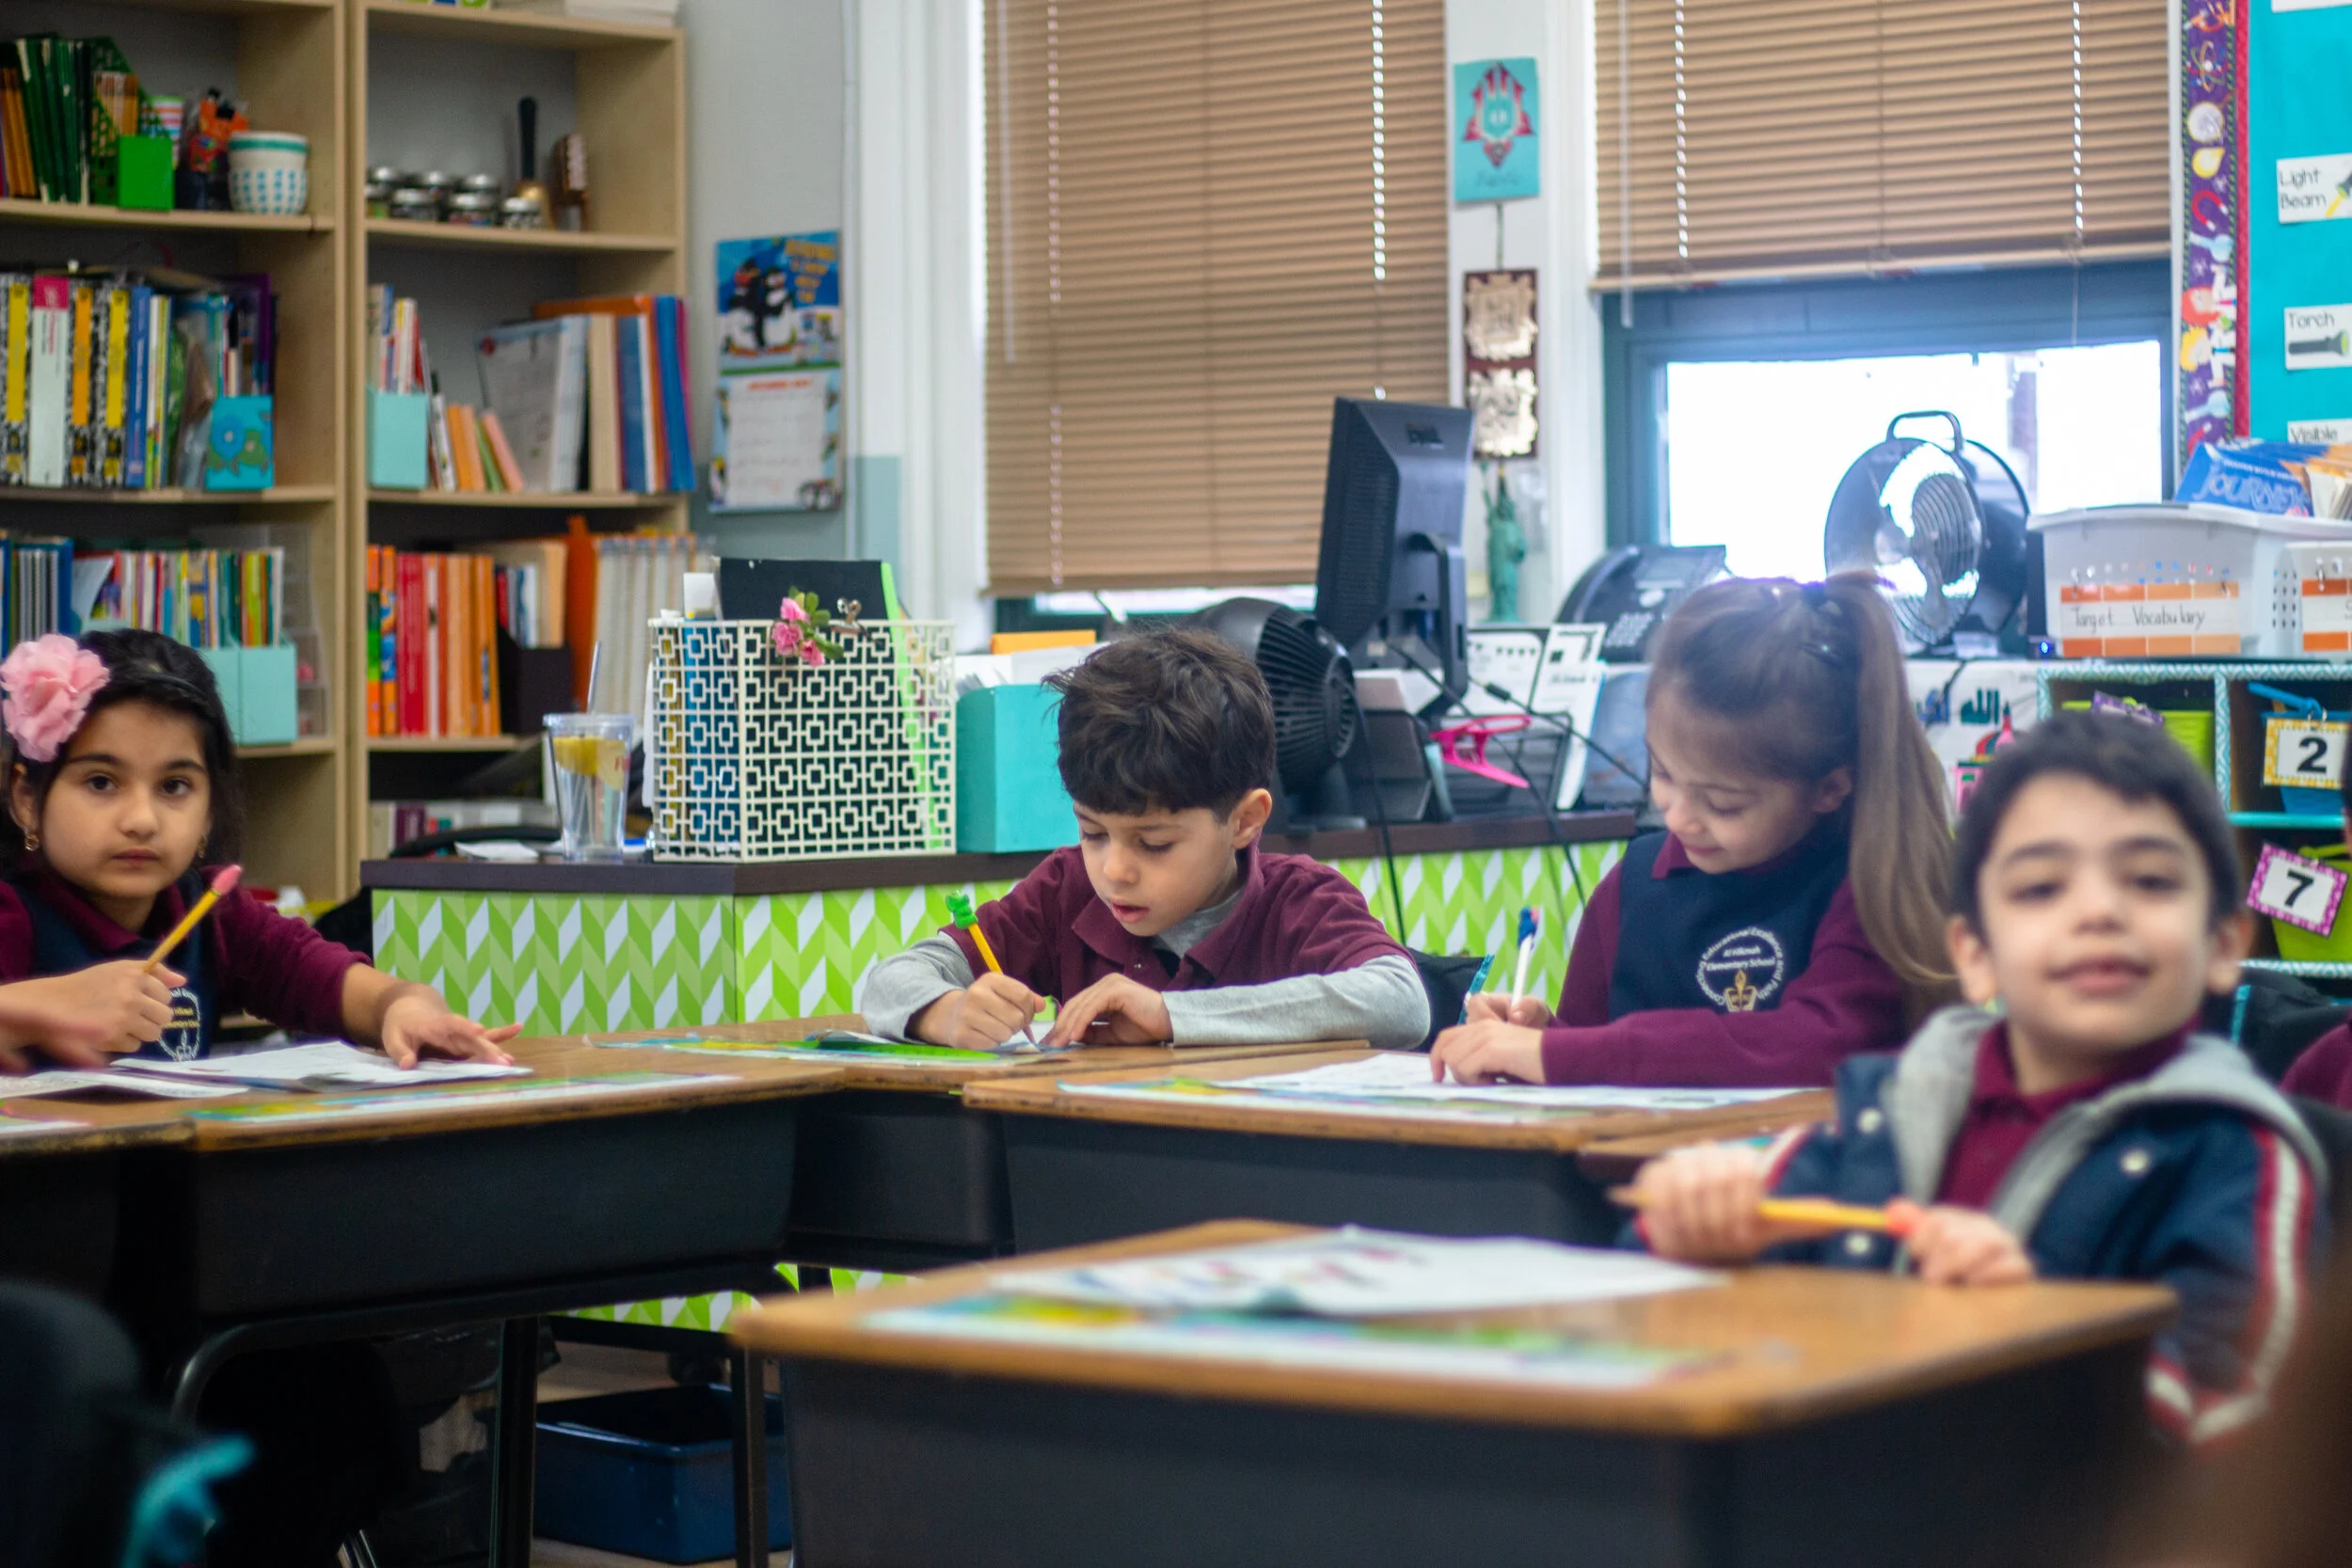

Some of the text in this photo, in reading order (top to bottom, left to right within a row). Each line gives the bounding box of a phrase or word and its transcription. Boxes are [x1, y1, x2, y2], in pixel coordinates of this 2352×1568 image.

[2280, 166, 2320, 189] Light
[2280, 192, 2327, 210] Beam
[2288, 310, 2335, 330] Torch
[2290, 425, 2338, 444] Visible
[2072, 605, 2206, 634] Target Vocabulary
[2296, 736, 2328, 774] 2
[2284, 868, 2314, 909] 7
[1748, 956, 1776, 968] School
